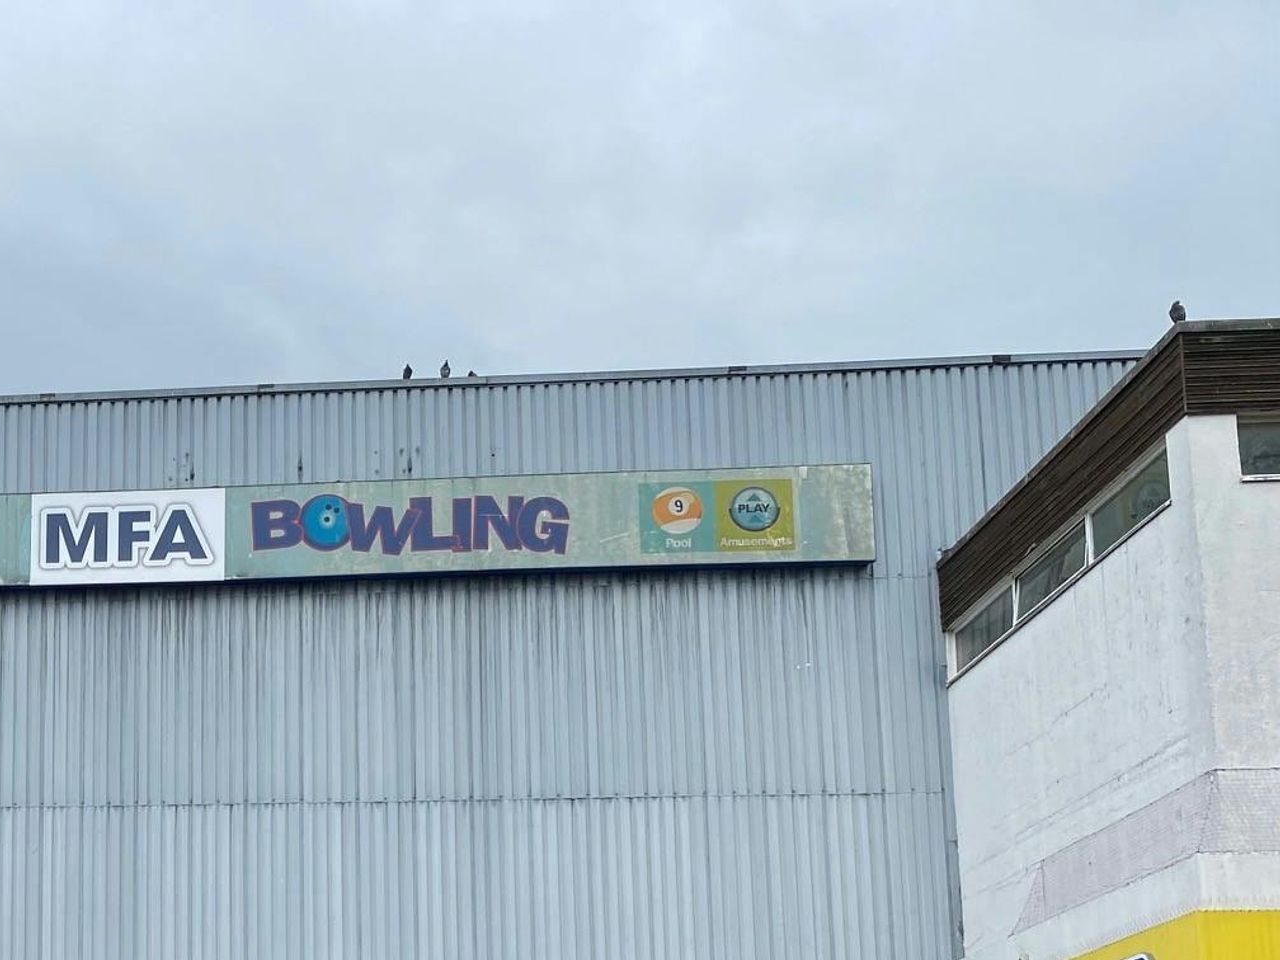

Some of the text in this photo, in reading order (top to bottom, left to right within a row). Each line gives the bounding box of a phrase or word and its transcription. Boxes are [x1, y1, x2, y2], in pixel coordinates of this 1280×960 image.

[674, 499, 684, 513] 9
[738, 503, 770, 514] PLAY
[249, 493, 570, 556] BOWLING
[44, 508, 210, 565] MFA
[665, 537, 692, 549] Pool
